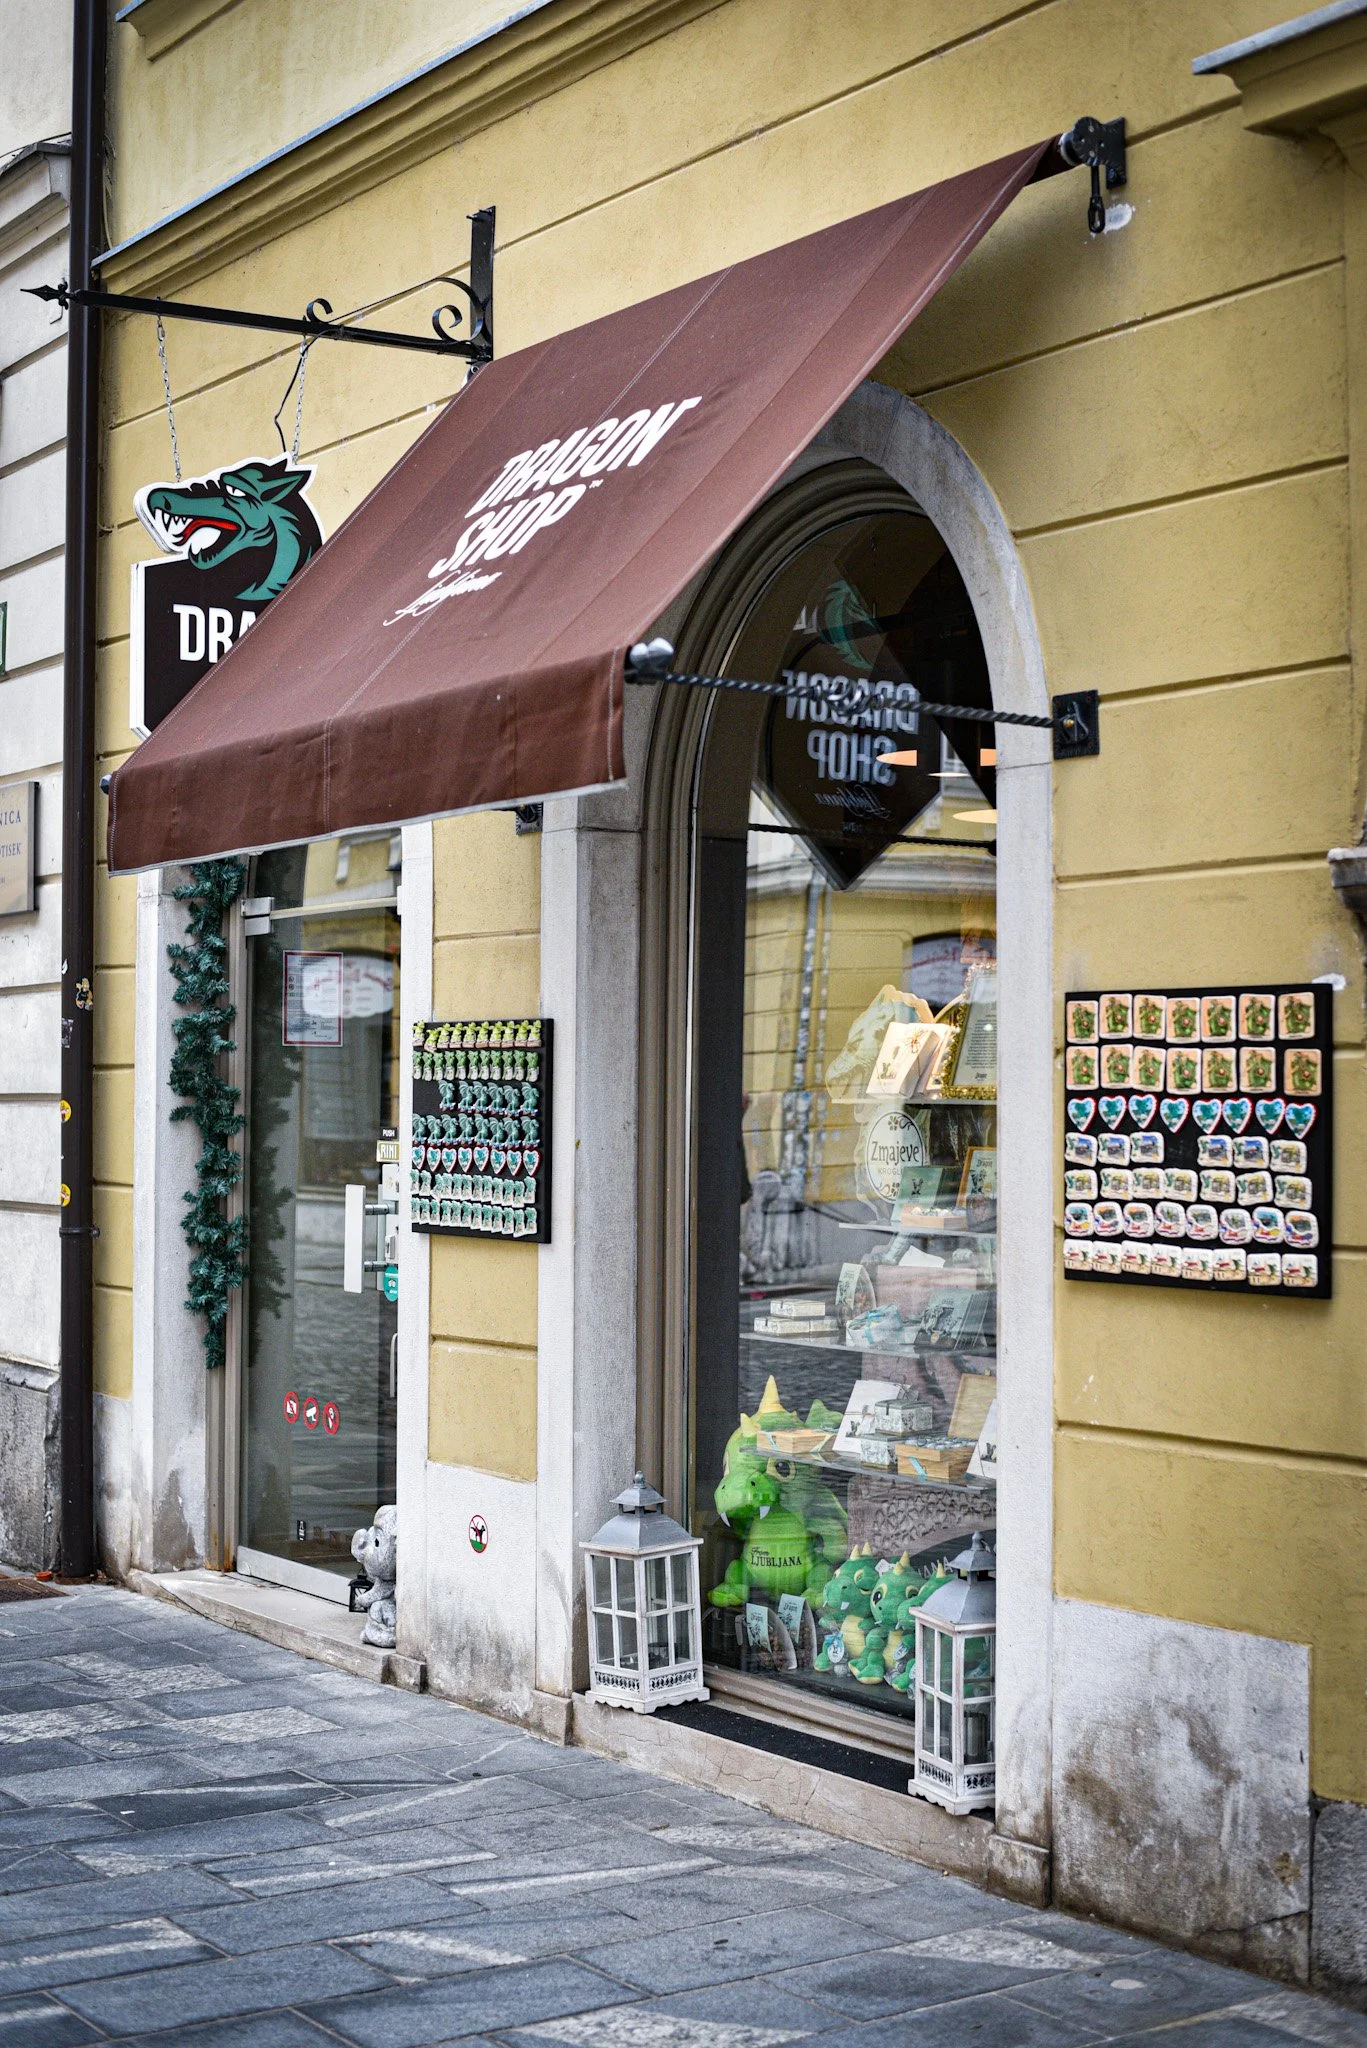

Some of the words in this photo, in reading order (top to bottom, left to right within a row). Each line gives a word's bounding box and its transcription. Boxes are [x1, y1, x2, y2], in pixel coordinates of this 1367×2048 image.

[464, 395, 703, 519] DRAGON
[427, 483, 587, 580] SHOP
[383, 1129, 395, 1137] PUSH
[870, 1140, 920, 1166] Zmajeve
[751, 1553, 803, 1568] LJUBLJANA
